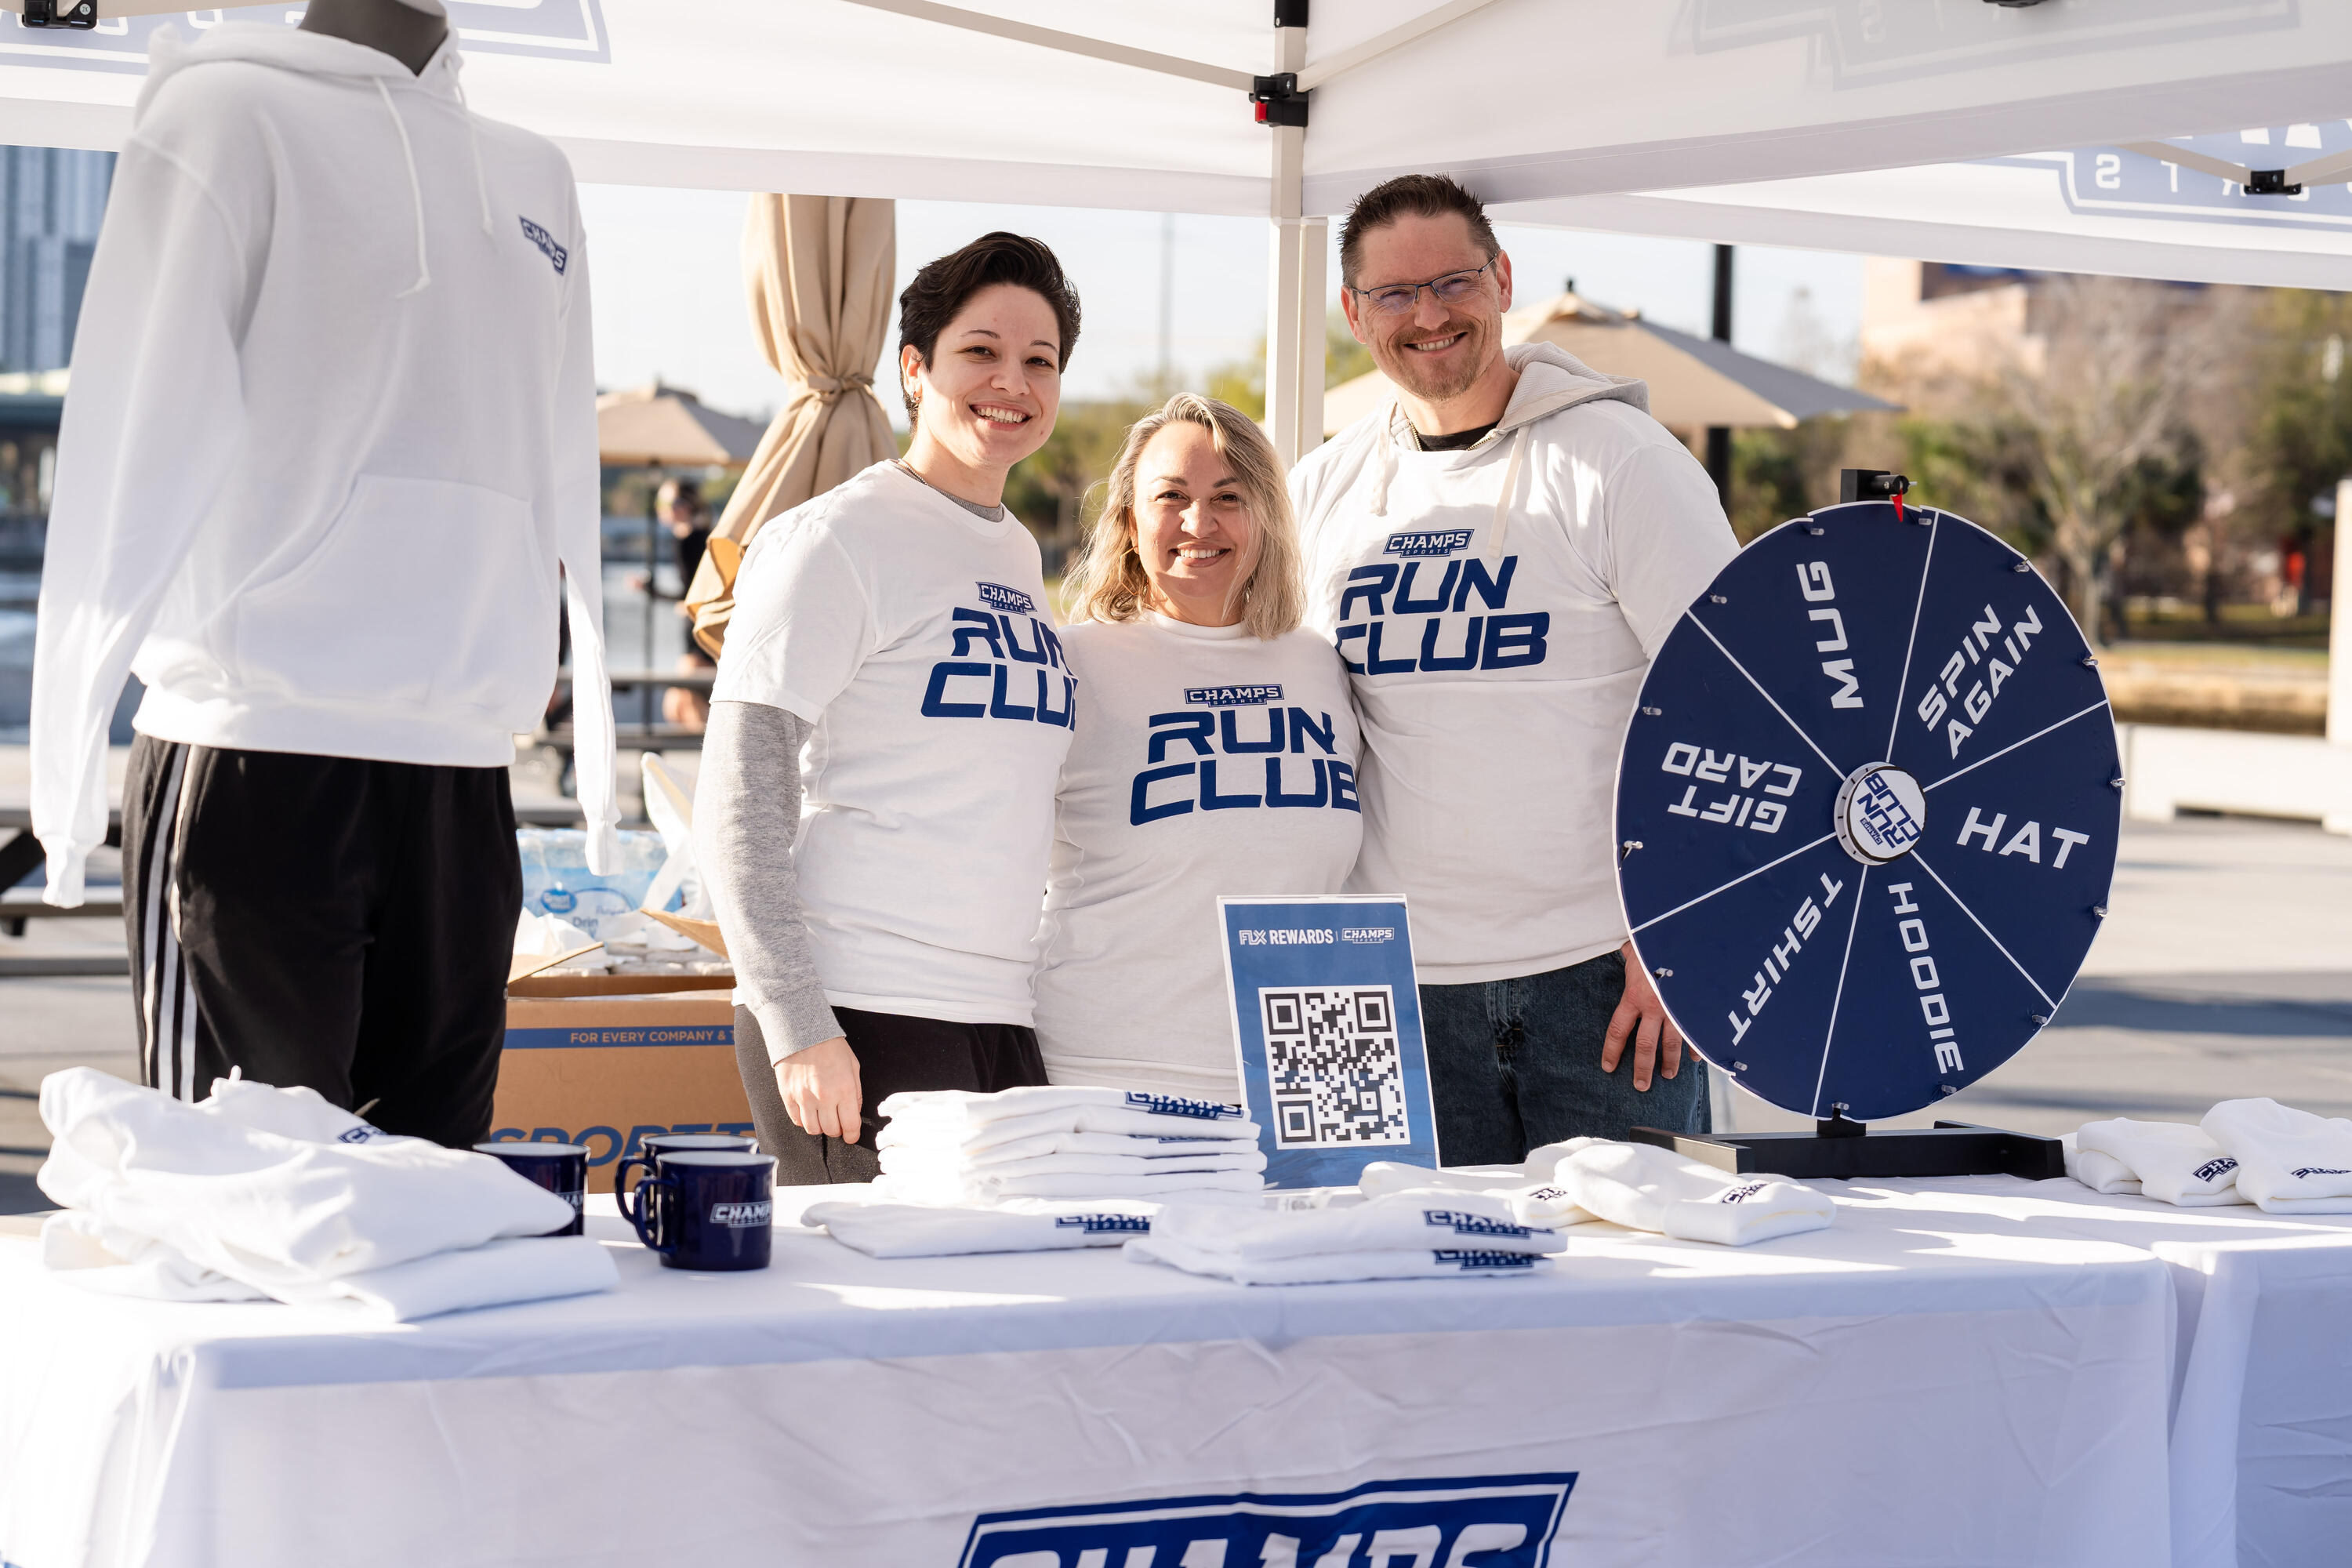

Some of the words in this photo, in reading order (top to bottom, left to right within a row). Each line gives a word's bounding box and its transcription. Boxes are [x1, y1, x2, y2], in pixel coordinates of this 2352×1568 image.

[1389, 532, 1468, 550] CHAMPS
[981, 585, 1033, 609] CHAMPS
[1340, 555, 1518, 621] RUN
[1335, 612, 1550, 676] CLUB
[1796, 561, 1864, 708] MUG
[920, 662, 1079, 732] CLU
[1189, 688, 1279, 701] CHAMPS
[1918, 603, 2002, 732] SPIN
[1948, 604, 2043, 760] AGAIN
[1148, 707, 1338, 764] RUN
[1130, 757, 1361, 826] CLUB
[1662, 742, 1802, 797] CARD
[1668, 786, 1788, 833] GIFT
[1857, 793, 1906, 848] RUN
[1864, 772, 1922, 842] CLUB
[1957, 807, 2090, 869] HAT
[1269, 928, 1334, 945] REWARDS
[1344, 930, 1392, 939] CHAMPS
[1729, 872, 1843, 1047] TSHIRT
[1888, 883, 1965, 1074] HOODIE
[571, 1033, 598, 1044] FOR
[602, 1032, 645, 1043] EVERY
[649, 1031, 713, 1042] COMPANY
[717, 1030, 726, 1040] &
[1156, 1104, 1215, 1118] SPORTS
